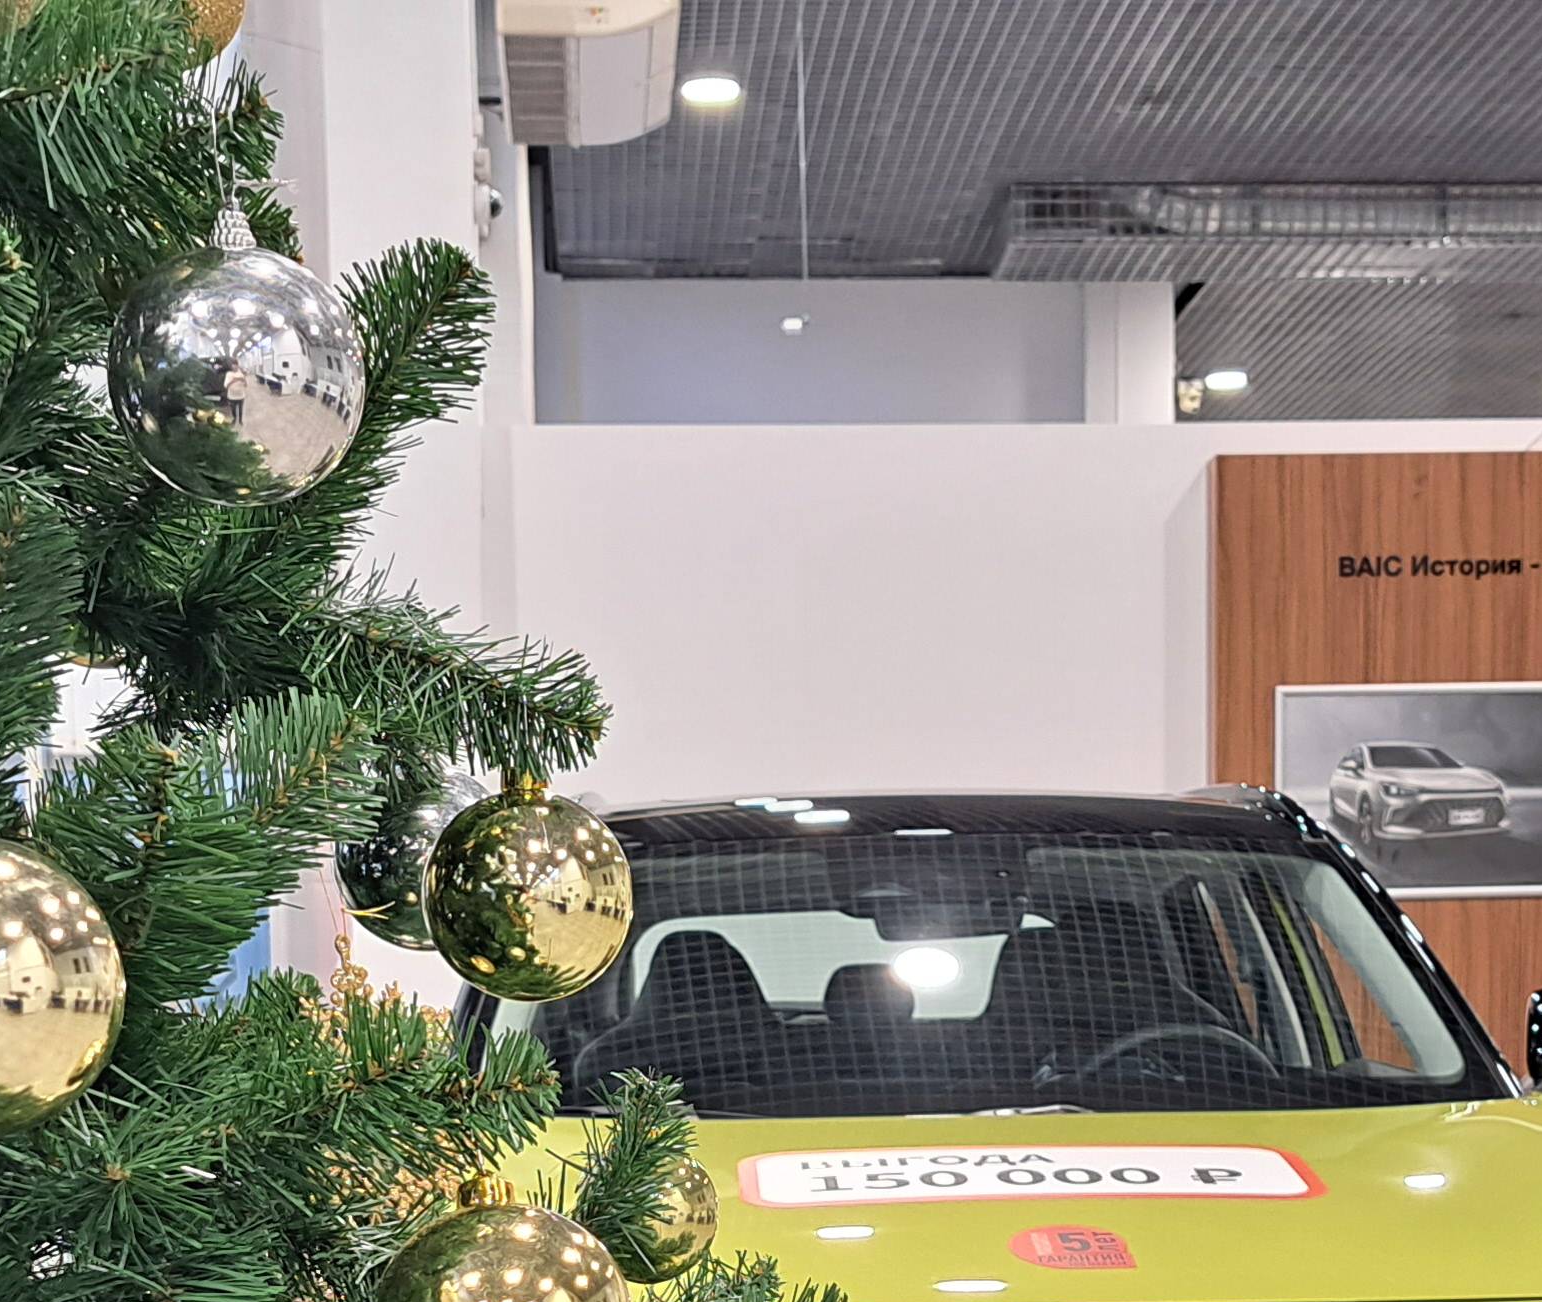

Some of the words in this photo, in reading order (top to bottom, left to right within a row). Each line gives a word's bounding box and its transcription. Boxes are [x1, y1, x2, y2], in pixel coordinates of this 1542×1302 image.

[1338, 555, 1403, 577] BAIC
[1411, 555, 1522, 579] История
[811, 1170, 968, 1192] 150
[997, 1167, 1161, 1186] 000
[1057, 1231, 1092, 1252] 5
